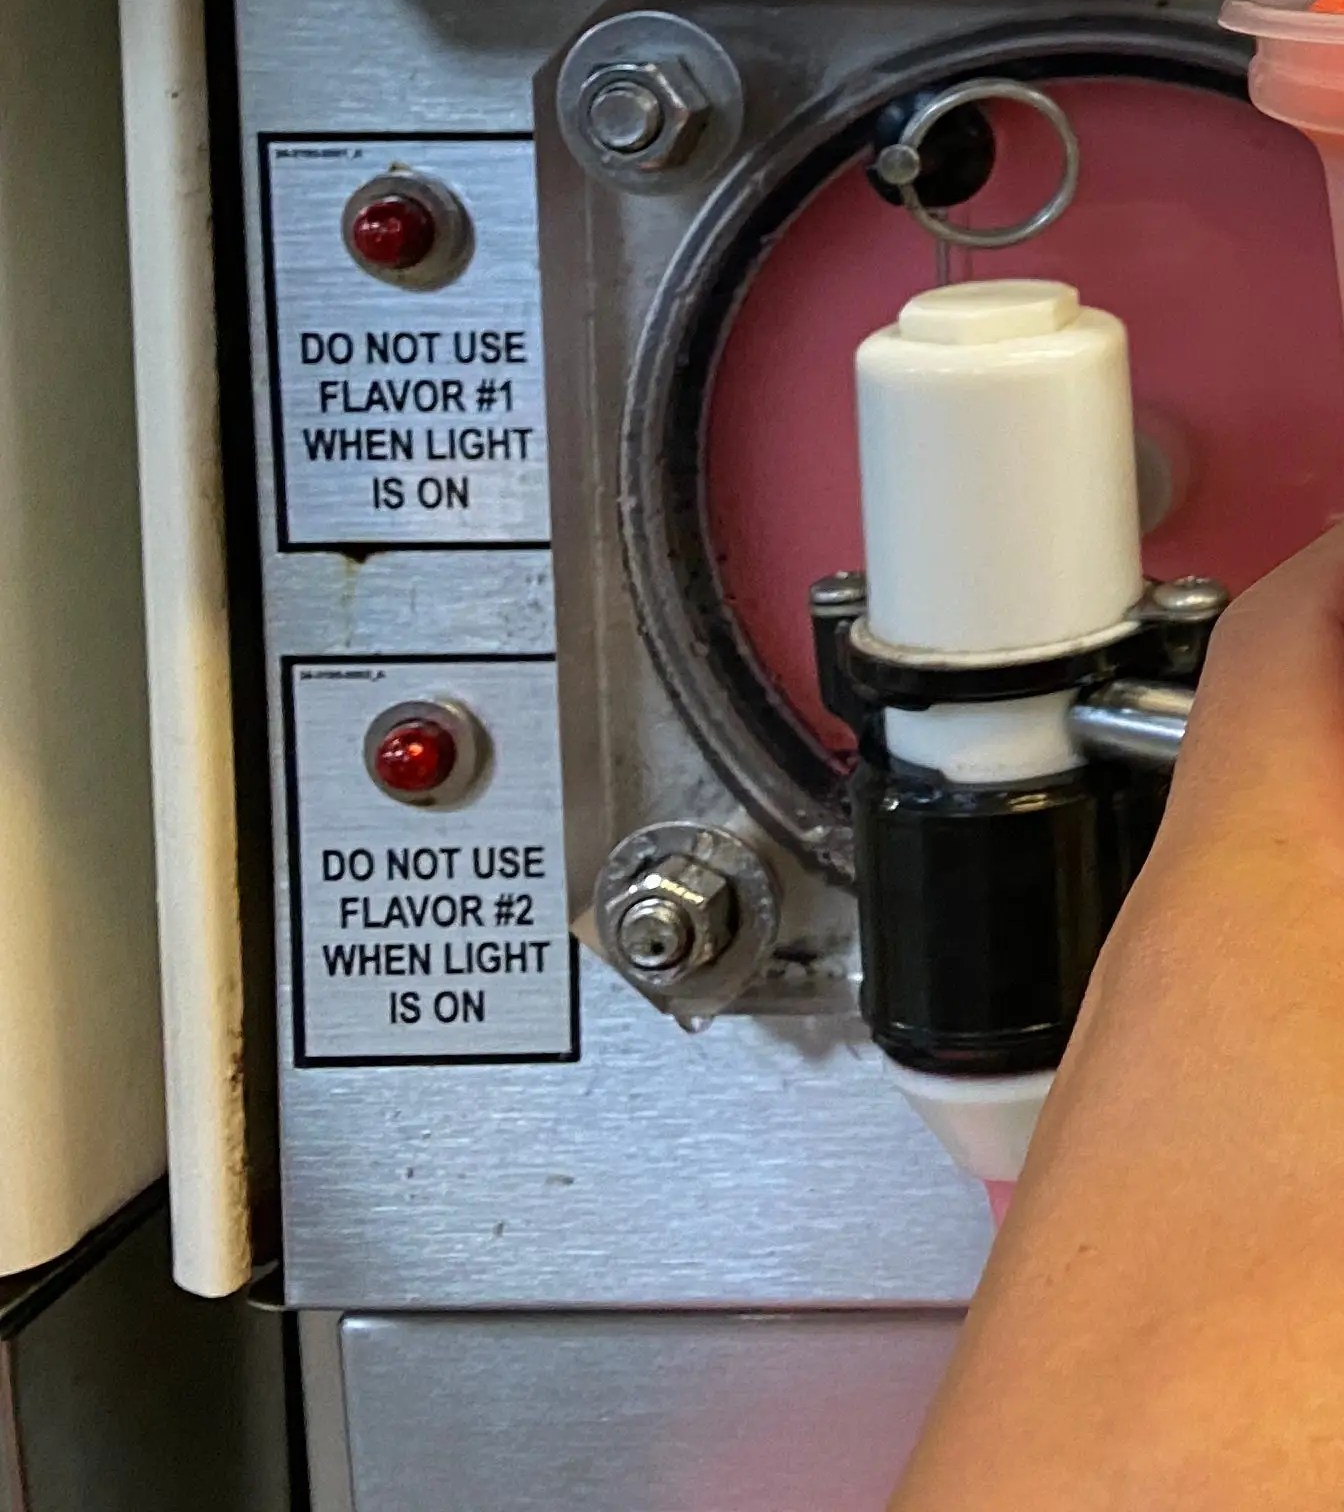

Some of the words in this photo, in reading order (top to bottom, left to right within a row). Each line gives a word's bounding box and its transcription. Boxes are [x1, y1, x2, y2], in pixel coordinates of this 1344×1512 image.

[300, 332, 353, 365] DO
[366, 332, 441, 364] NOT
[455, 331, 527, 364] USE
[319, 379, 465, 413] FLAVOR
[476, 379, 514, 413] #1
[303, 428, 414, 461] WHEN
[427, 428, 533, 461] LIGHT
[373, 476, 405, 509] IS
[417, 477, 469, 510] ON
[322, 849, 374, 881] DO
[387, 848, 461, 880] NOT
[473, 846, 546, 879] USE
[340, 895, 484, 929] FLAVOR
[494, 893, 534, 926] #2
[323, 942, 431, 977] WHEN
[444, 941, 550, 975] LIGHT
[390, 991, 421, 1023] IS
[434, 991, 485, 1023] ON
